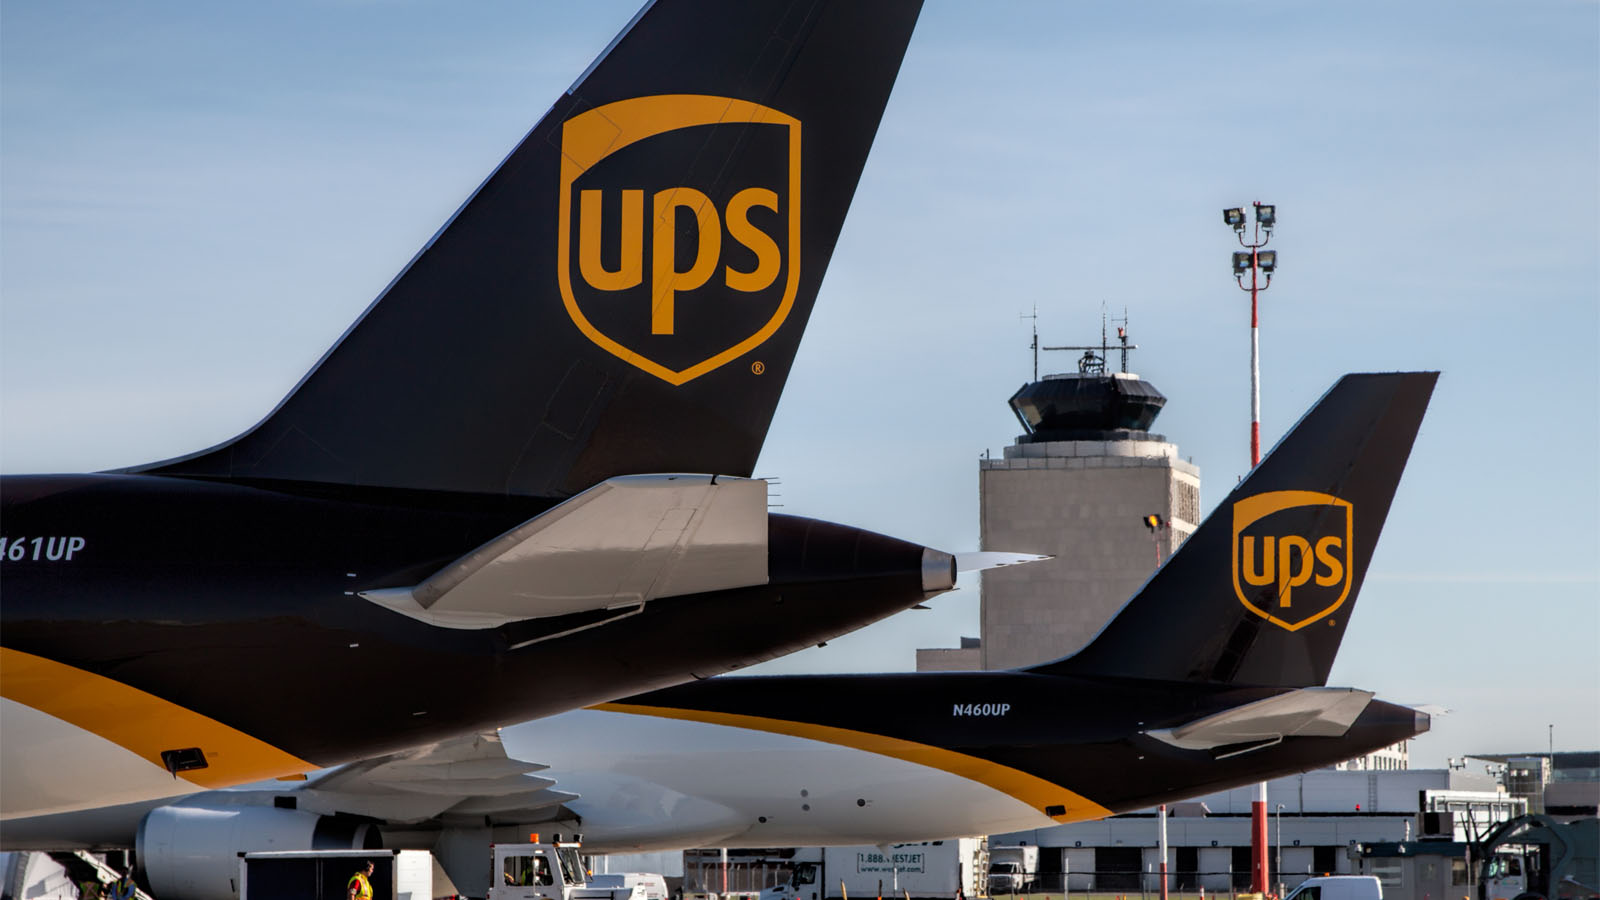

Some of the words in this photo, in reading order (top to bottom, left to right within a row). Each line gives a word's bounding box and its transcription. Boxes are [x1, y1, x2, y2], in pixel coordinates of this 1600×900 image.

[579, 187, 781, 335] ups
[1243, 535, 1343, 607] ups
[953, 704, 1011, 716] N460UP
